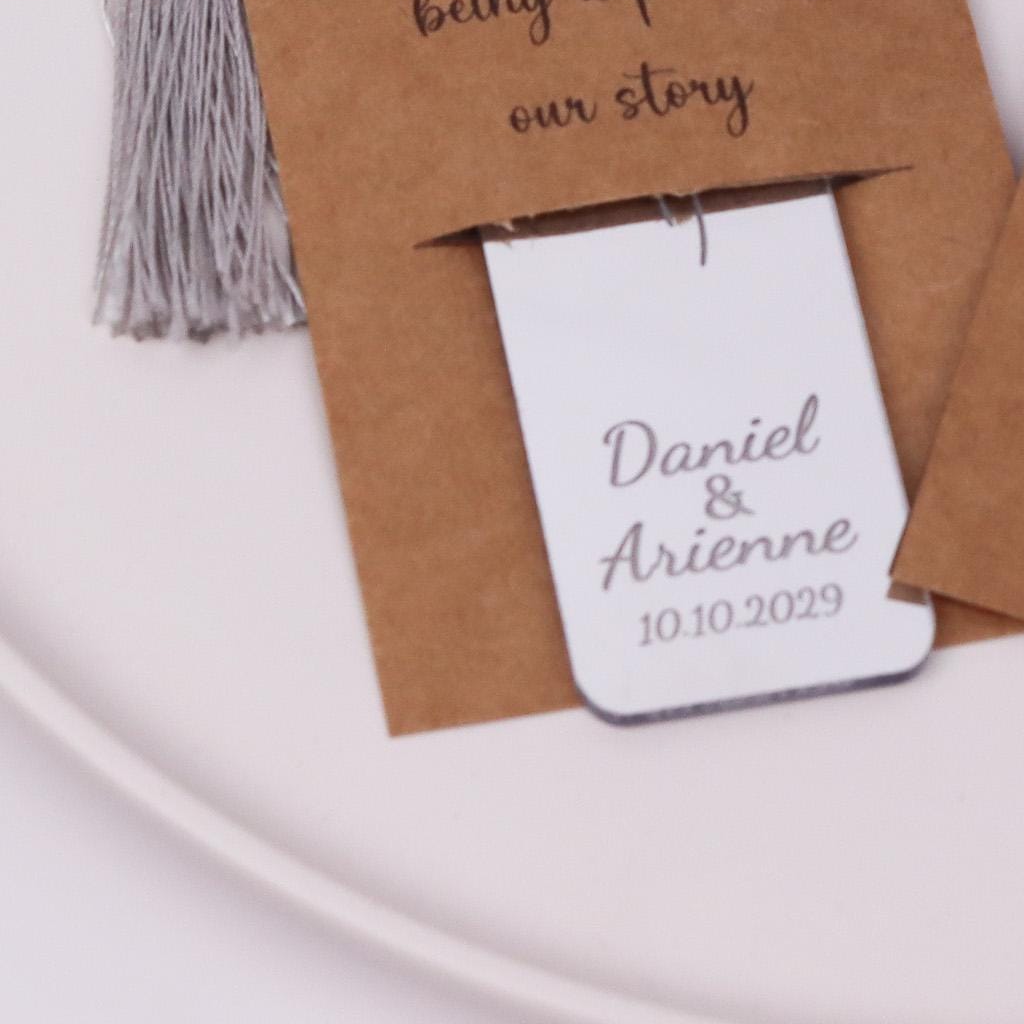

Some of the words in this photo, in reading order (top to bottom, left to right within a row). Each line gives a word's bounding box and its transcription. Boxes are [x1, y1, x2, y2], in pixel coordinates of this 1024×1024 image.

[510, 100, 597, 133] our
[615, 61, 753, 137] story
[603, 393, 820, 487] Daniel
[704, 473, 754, 520] &
[599, 518, 858, 591] Arienne
[637, 583, 844, 647] 10.10.2029
